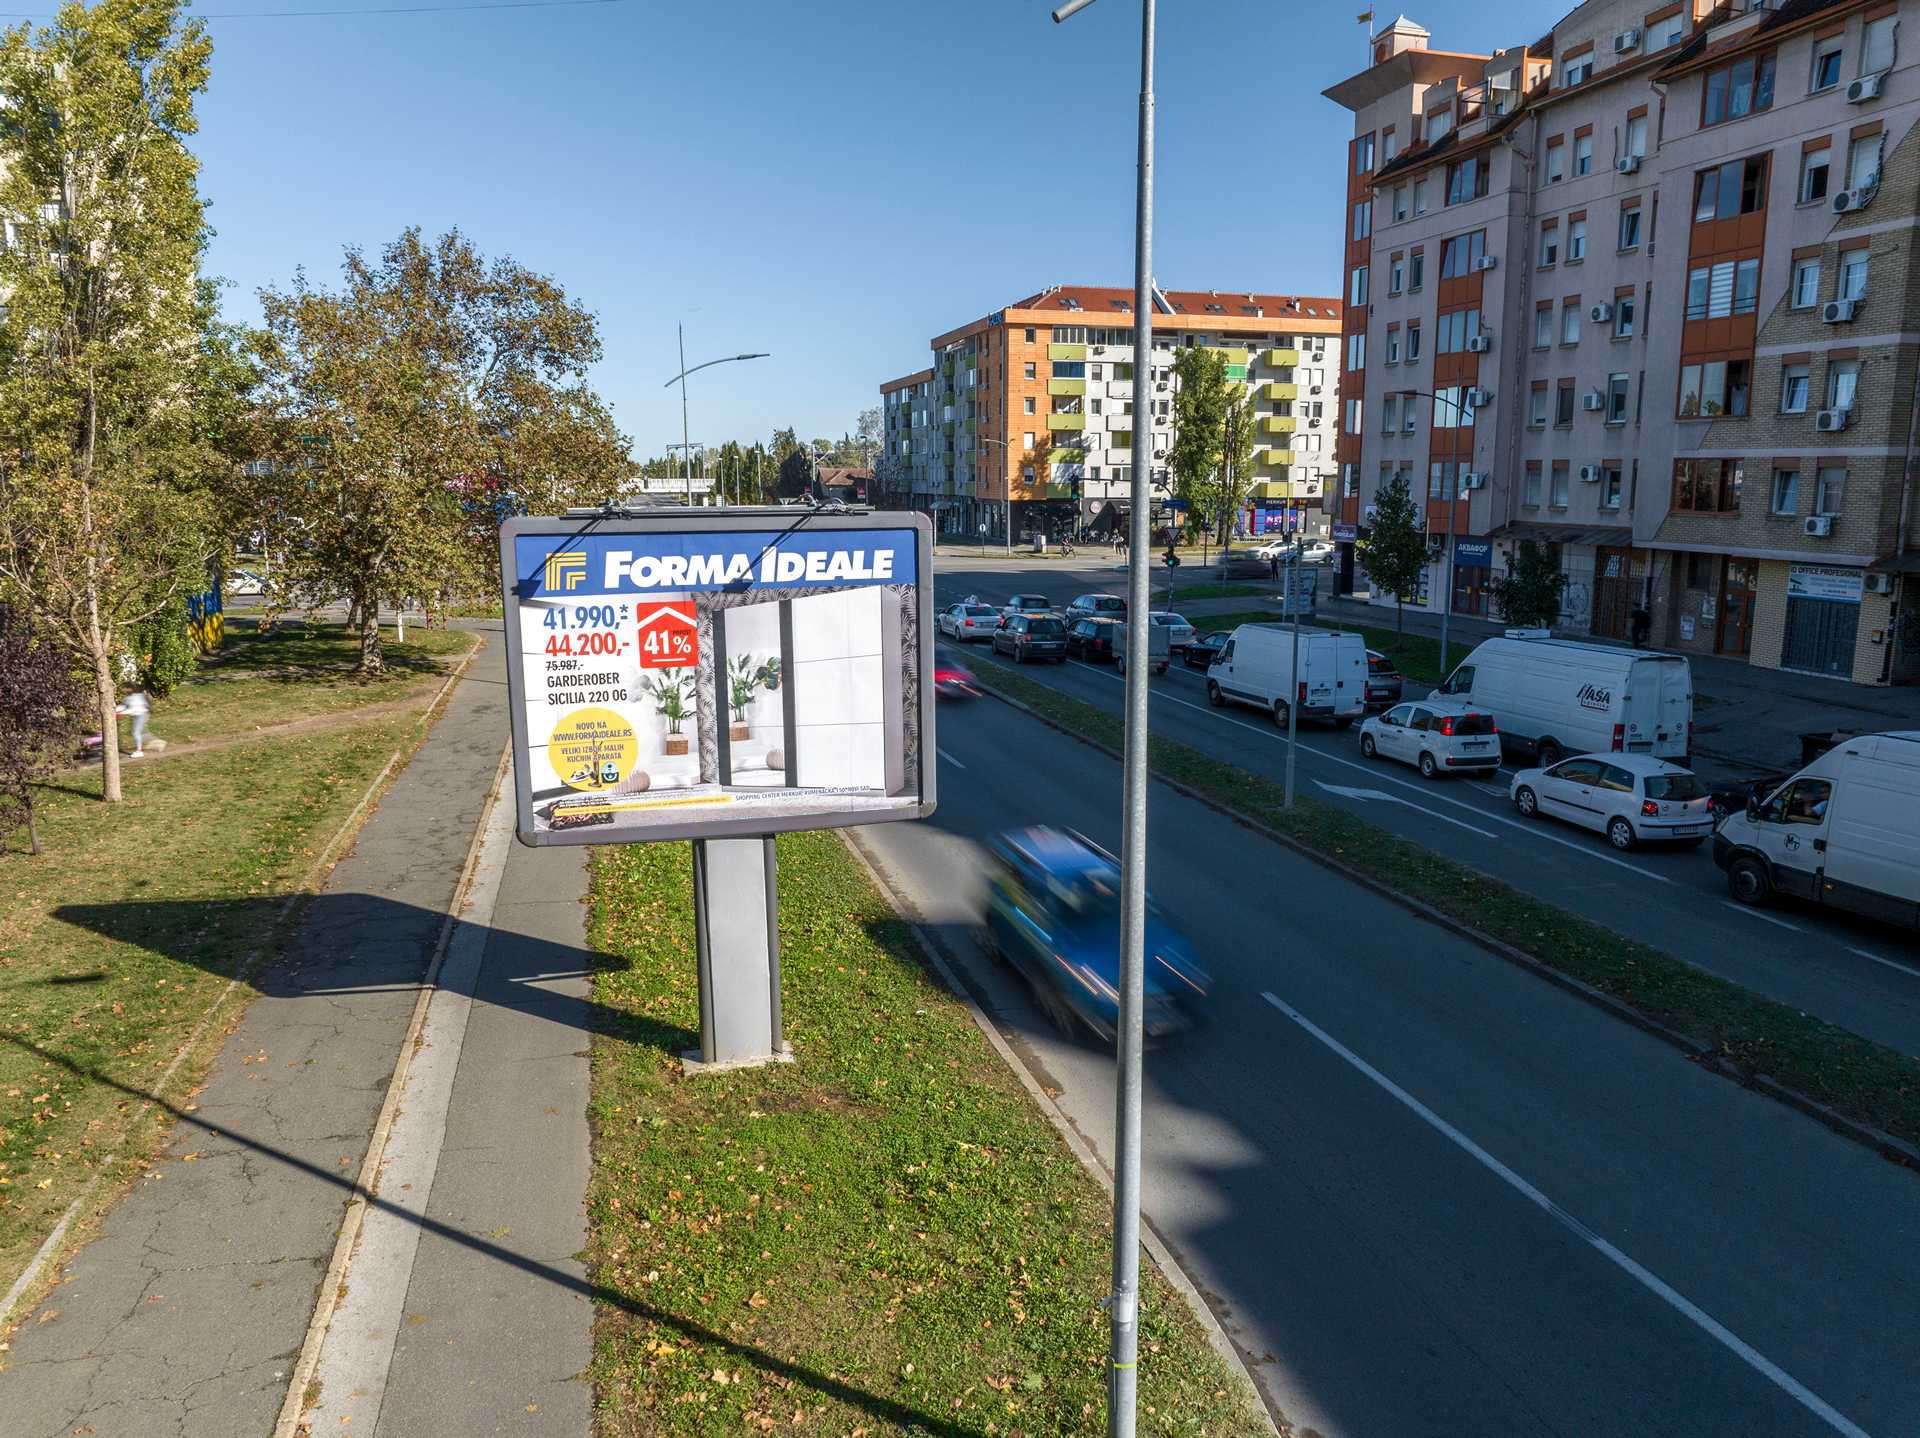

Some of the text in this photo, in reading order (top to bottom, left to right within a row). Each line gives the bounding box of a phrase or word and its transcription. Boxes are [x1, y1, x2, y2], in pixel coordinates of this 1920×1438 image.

[604, 546, 894, 588] FORMA IDEALE
[1798, 567, 1819, 575] OFFICE
[545, 632, 630, 657] 44.200,-
[643, 630, 692, 655] 41%
[547, 672, 620, 688] GARDEROBER
[548, 688, 628, 705] SICILIA 220 OG
[576, 721, 607, 730] NOVO NA
[553, 729, 632, 742] WWW.FORMAIDEALE.RS
[561, 743, 624, 755] VELIKI IZBOR MALIH
[593, 752, 622, 760] APARATA
[736, 793, 760, 801] SHOPPING
